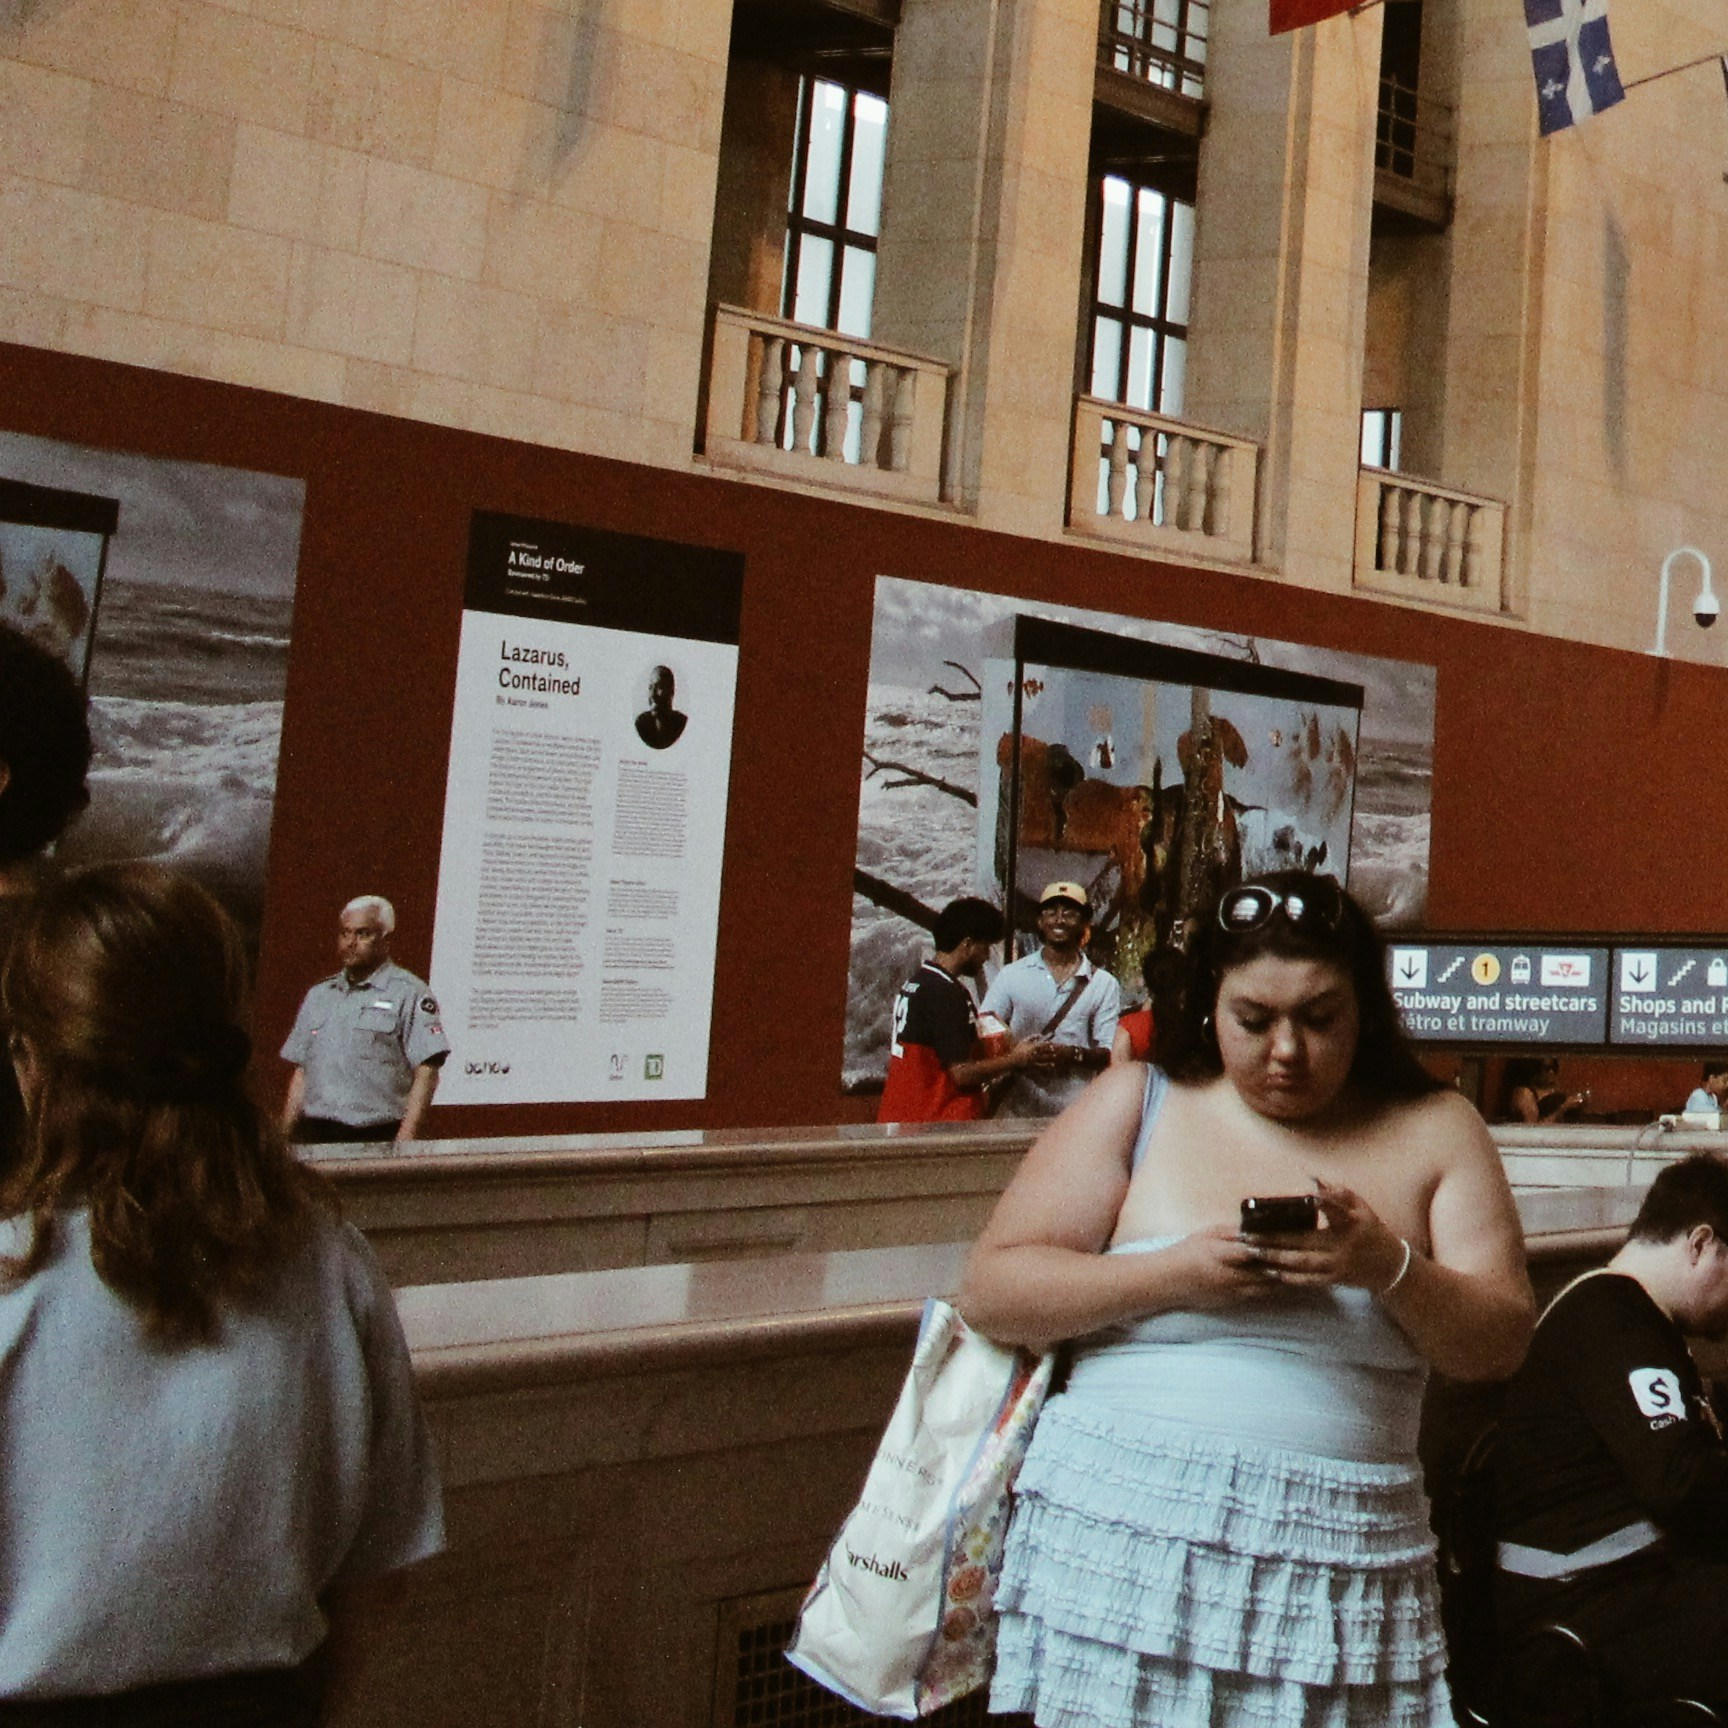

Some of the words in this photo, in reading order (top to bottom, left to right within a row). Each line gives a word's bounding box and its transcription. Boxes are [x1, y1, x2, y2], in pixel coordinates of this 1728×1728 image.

[508, 550, 516, 565] A
[518, 551, 542, 569] Kind
[543, 556, 555, 571] of
[555, 558, 586, 575] Order
[501, 640, 570, 671] Lazarus,
[499, 667, 581, 695] Contained
[1481, 962, 1490, 978] 1
[1393, 991, 1462, 1014] Subway
[1466, 992, 1500, 1011] and
[1504, 993, 1598, 1012] streetcars
[1619, 995, 1676, 1019] Shops
[1681, 996, 1716, 1015] and
[1401, 1014, 1442, 1032] étro
[1447, 1016, 1466, 1032] et
[1470, 1018, 1550, 1036] tramway
[1620, 1018, 1706, 1039] Magasins
[846, 1542, 909, 1582] arshalls
